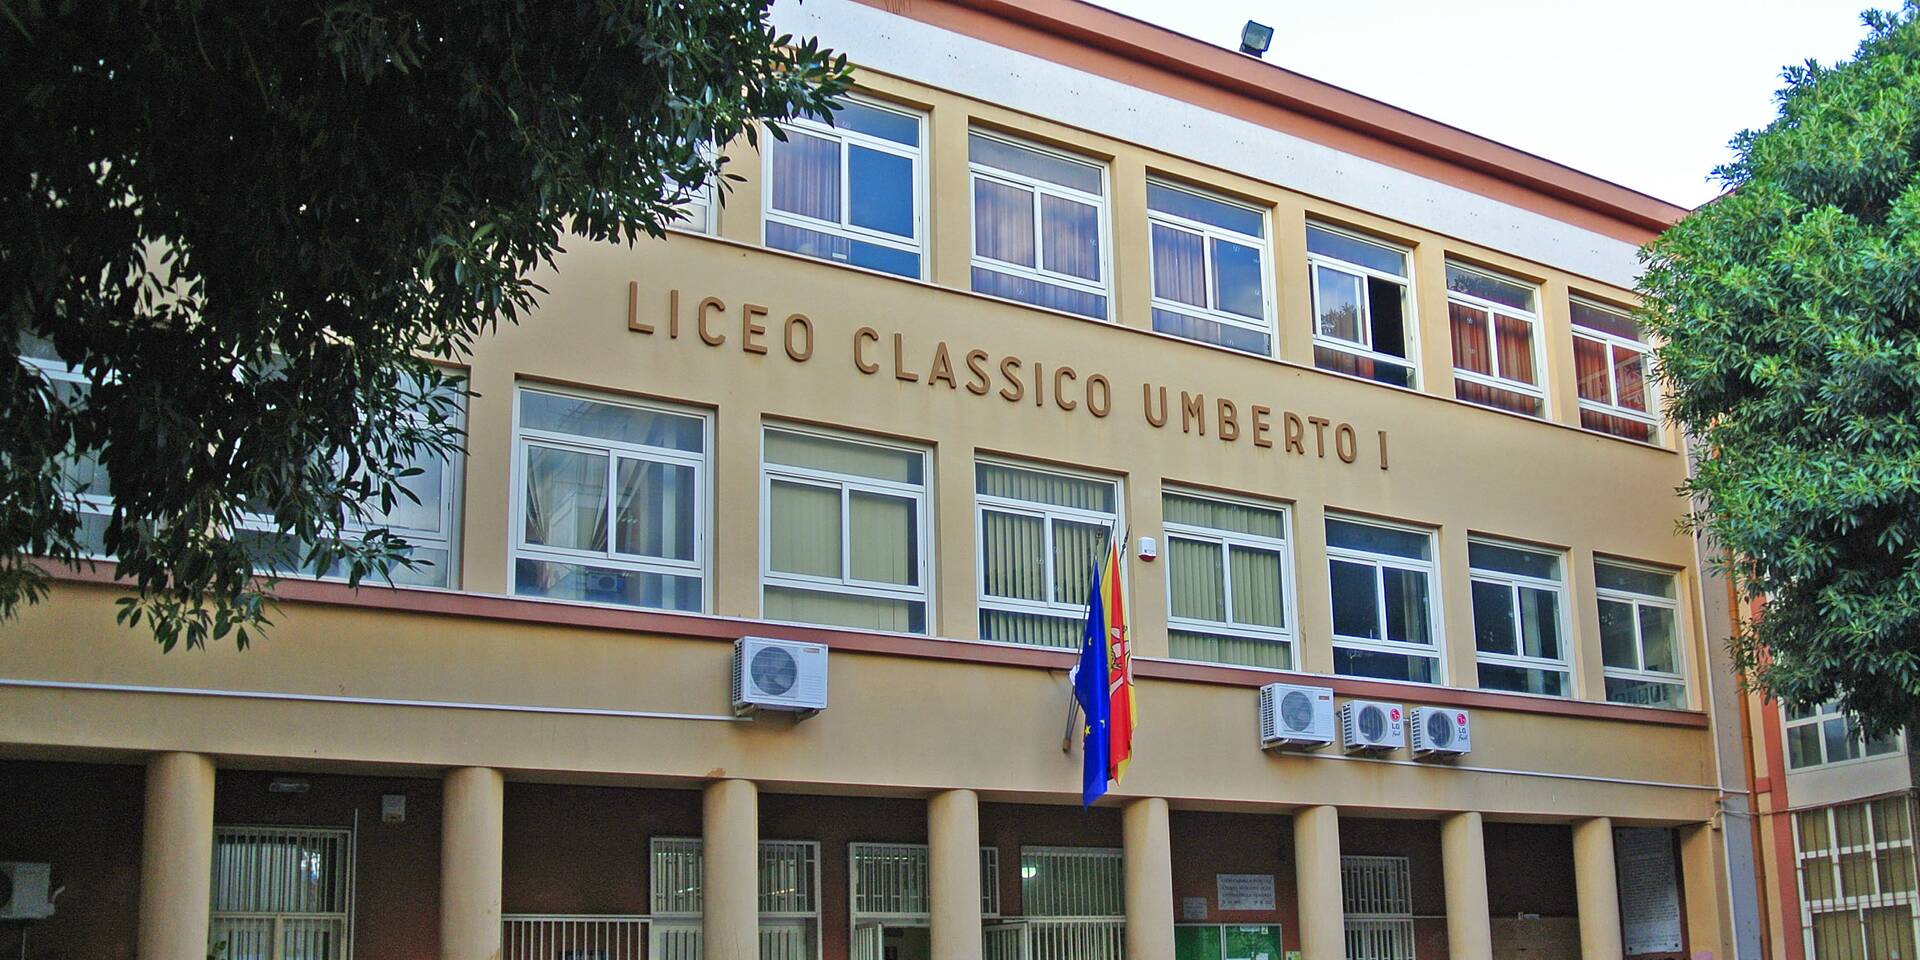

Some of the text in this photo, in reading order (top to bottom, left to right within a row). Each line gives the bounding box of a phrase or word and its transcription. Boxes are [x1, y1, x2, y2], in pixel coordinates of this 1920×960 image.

[628, 281, 1388, 470] LICEO CLASSICO UMBERTO I
